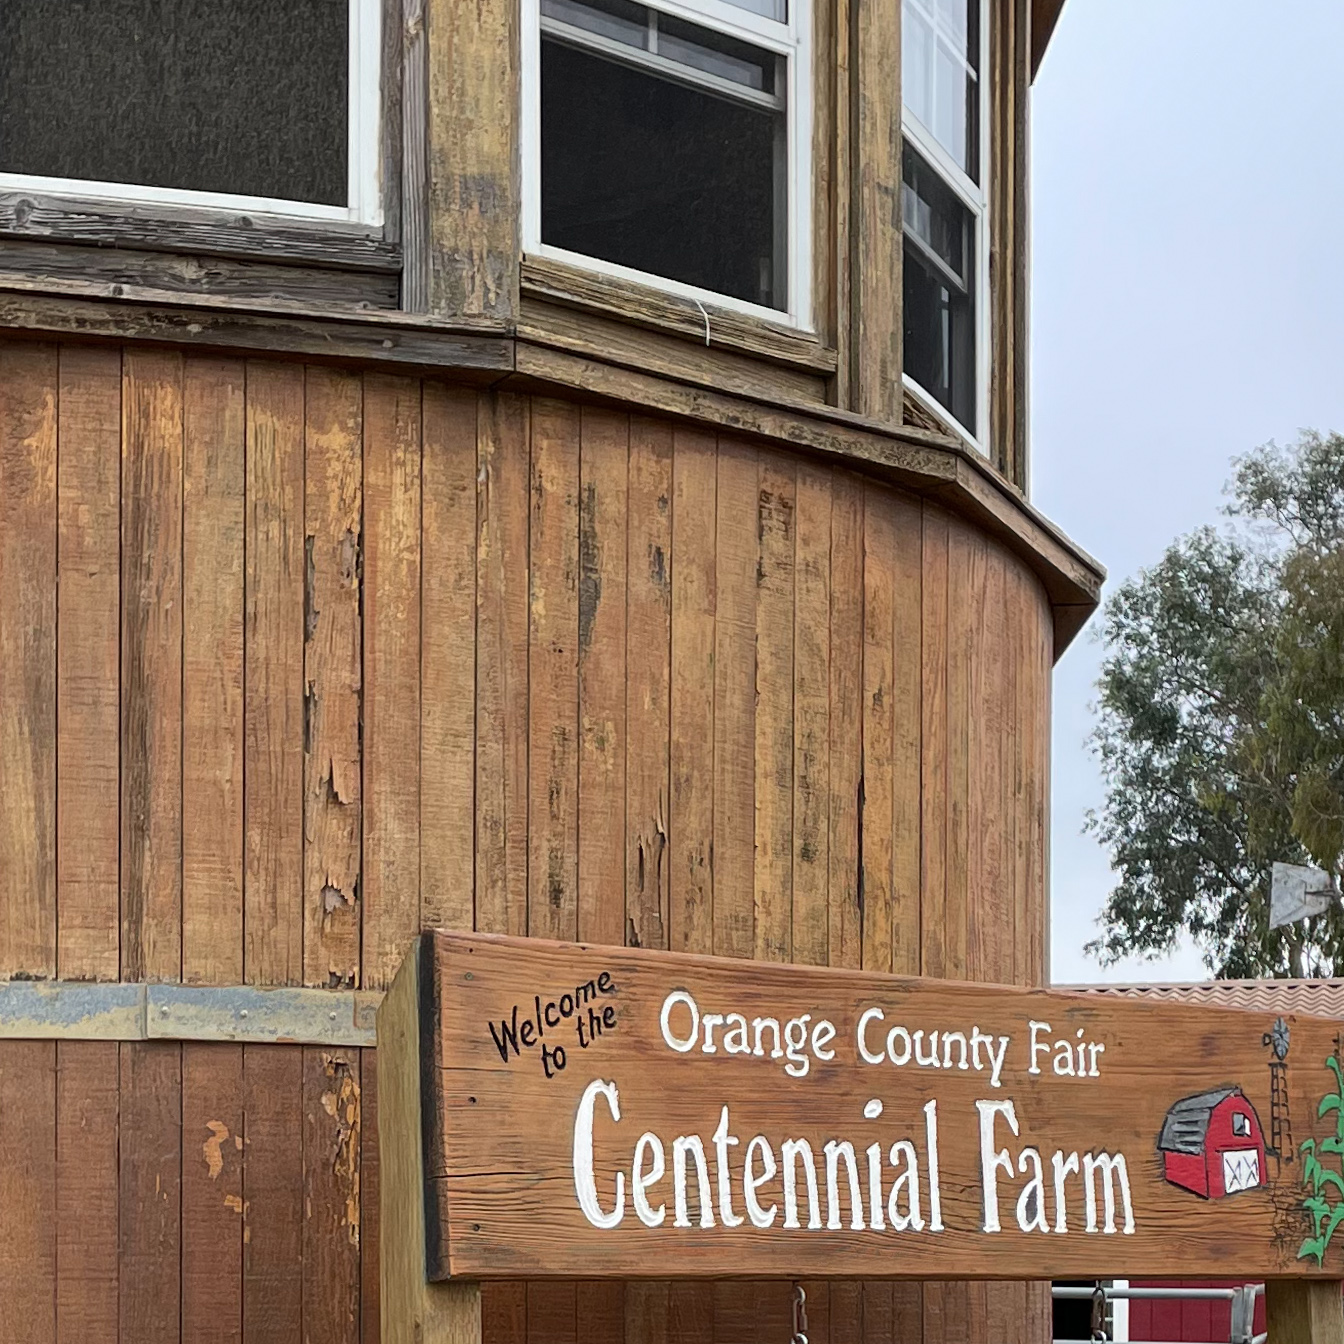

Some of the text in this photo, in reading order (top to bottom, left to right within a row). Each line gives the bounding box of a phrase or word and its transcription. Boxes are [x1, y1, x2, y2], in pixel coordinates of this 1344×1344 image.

[488, 971, 615, 1063] Welcome
[541, 1006, 618, 1079] to the
[659, 989, 1106, 1088] Orange County Fair
[572, 1078, 1136, 1235] Centennial Farm
